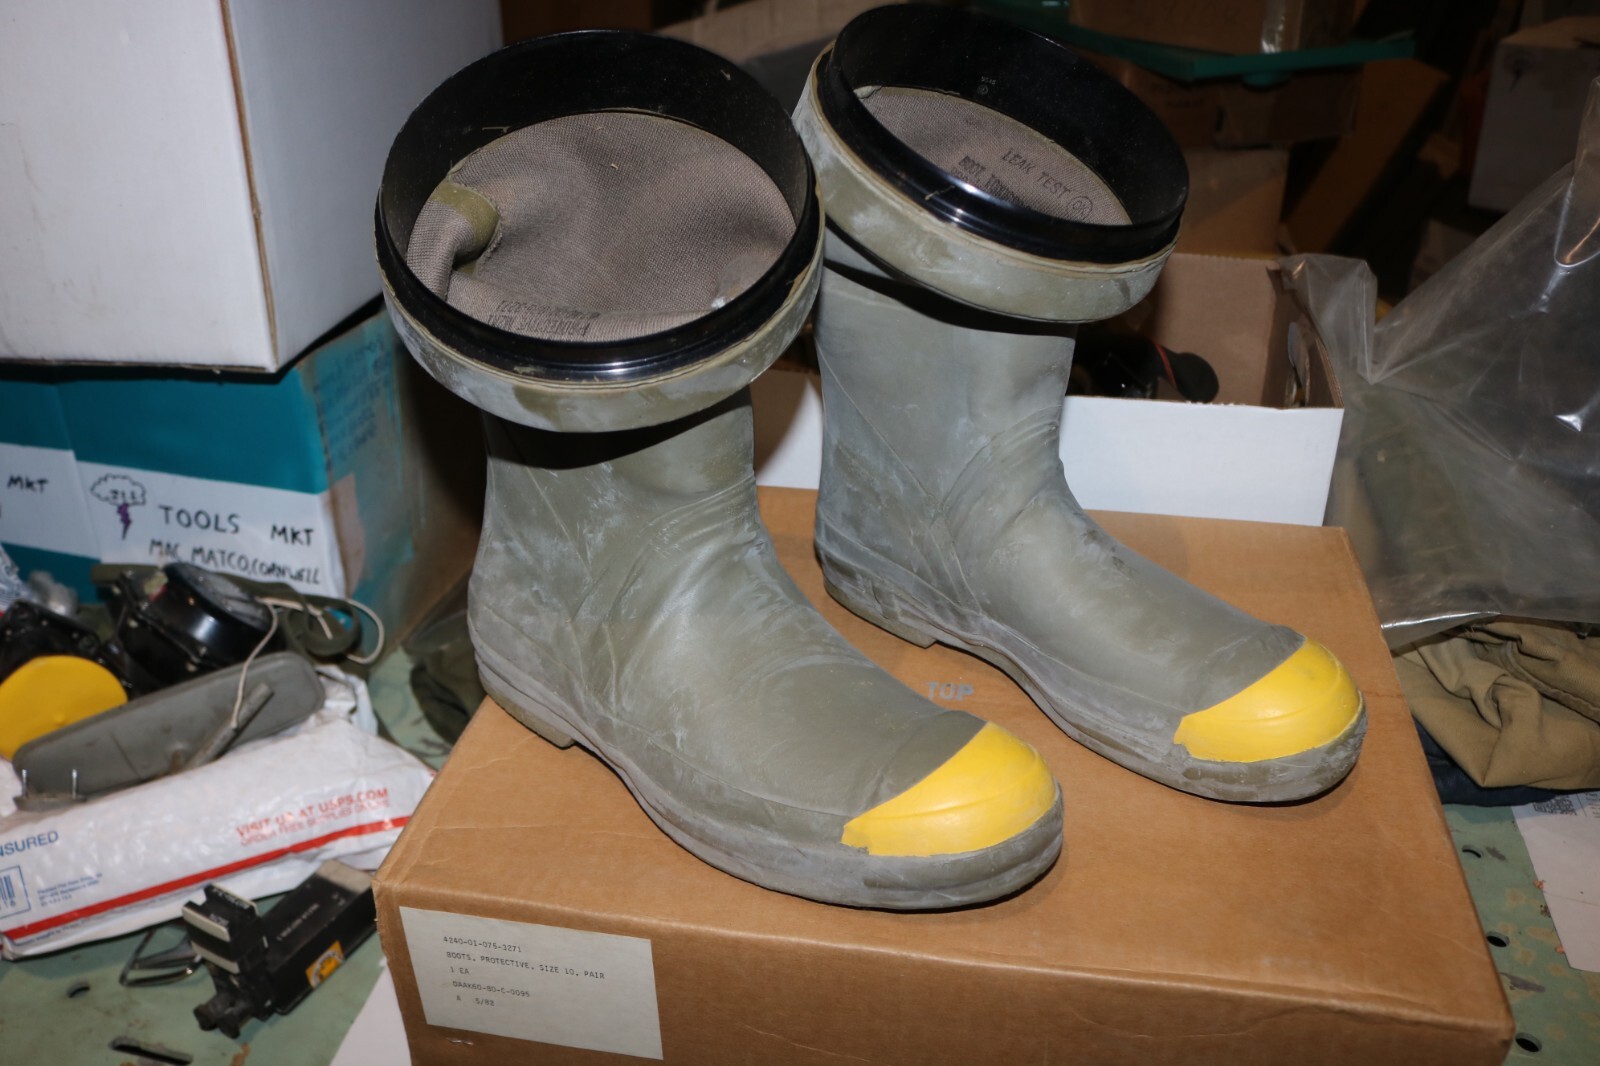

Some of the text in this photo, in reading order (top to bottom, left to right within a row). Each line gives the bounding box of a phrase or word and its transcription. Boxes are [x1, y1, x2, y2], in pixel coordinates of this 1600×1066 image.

[1001, 147, 1035, 174] LEAK
[1037, 171, 1071, 199] TEST
[6, 474, 50, 494] MKT
[158, 504, 315, 547] TOOLS MKT
[926, 681, 974, 701] TOP
[299, 804, 315, 817] AT
[443, 936, 522, 953] 4240-01-075-3271
[459, 967, 470, 975] EA
[539, 964, 559, 974] SIZE
[584, 970, 605, 979] PAIR
